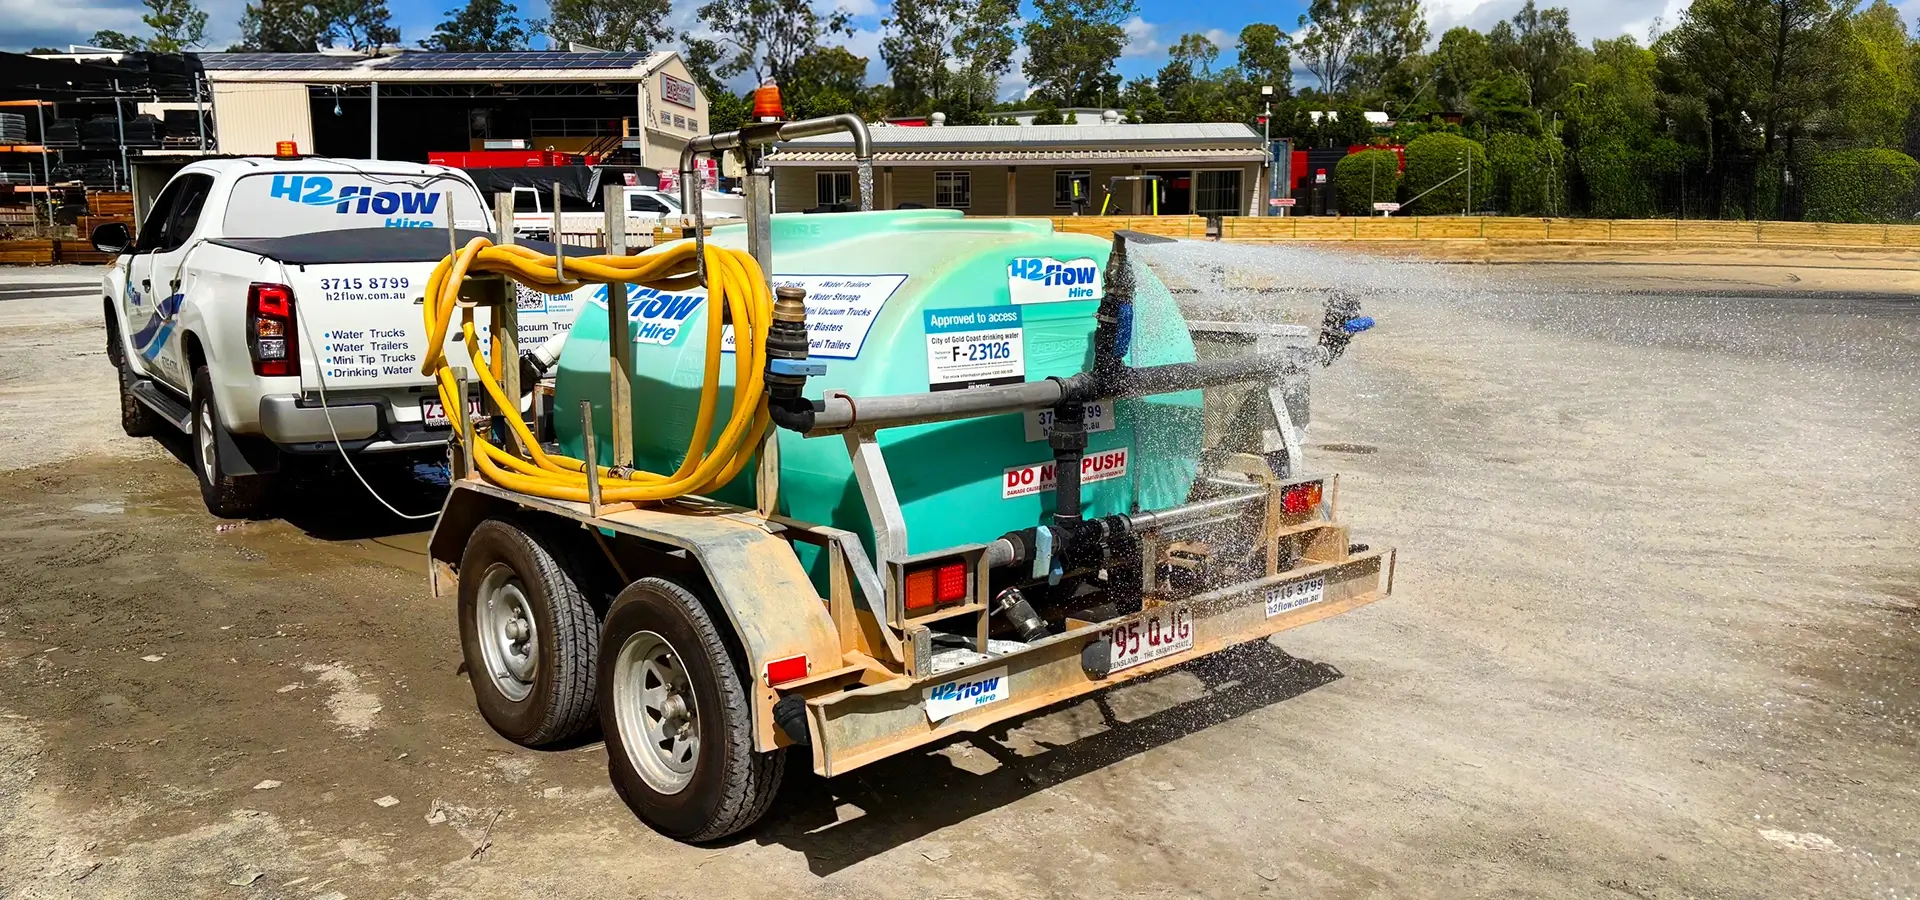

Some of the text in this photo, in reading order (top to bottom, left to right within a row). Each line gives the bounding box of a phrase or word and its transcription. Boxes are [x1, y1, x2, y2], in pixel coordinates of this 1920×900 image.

[320, 277, 410, 290] 3715 8799
[326, 291, 406, 301] h2flow.com.au
[811, 293, 861, 303] Water Storage
[1068, 287, 1094, 298] Hire
[818, 307, 846, 316] Vacuum
[846, 308, 872, 317] Trucks
[552, 321, 573, 331] Truc
[931, 312, 1018, 328] Approved to access
[638, 322, 676, 341] Hire
[814, 323, 844, 332] Blasters
[331, 328, 406, 340] Water Trucks
[931, 337, 943, 345] City
[951, 335, 965, 343] Gold
[965, 334, 982, 342] Coast
[982, 332, 1004, 341] drinking
[1005, 332, 1019, 340] water
[332, 341, 409, 352] Water Trailers
[808, 339, 852, 350] Fuel Trailers
[333, 353, 416, 366] Mini Tip Trucks
[334, 366, 413, 378] Drinking Water
[1039, 411, 1053, 425] 37
[1007, 467, 1034, 488] DO
[1081, 451, 1125, 474] PUSH
[1006, 487, 1026, 496] DAMAGE
[1026, 484, 1041, 493] CAUSED
[1266, 586, 1293, 604] 3715
[1267, 593, 1319, 615] h2flow.com.au
[1110, 639, 1189, 670] EENSLAND THE SMART STATE
[975, 693, 997, 705] Hire
